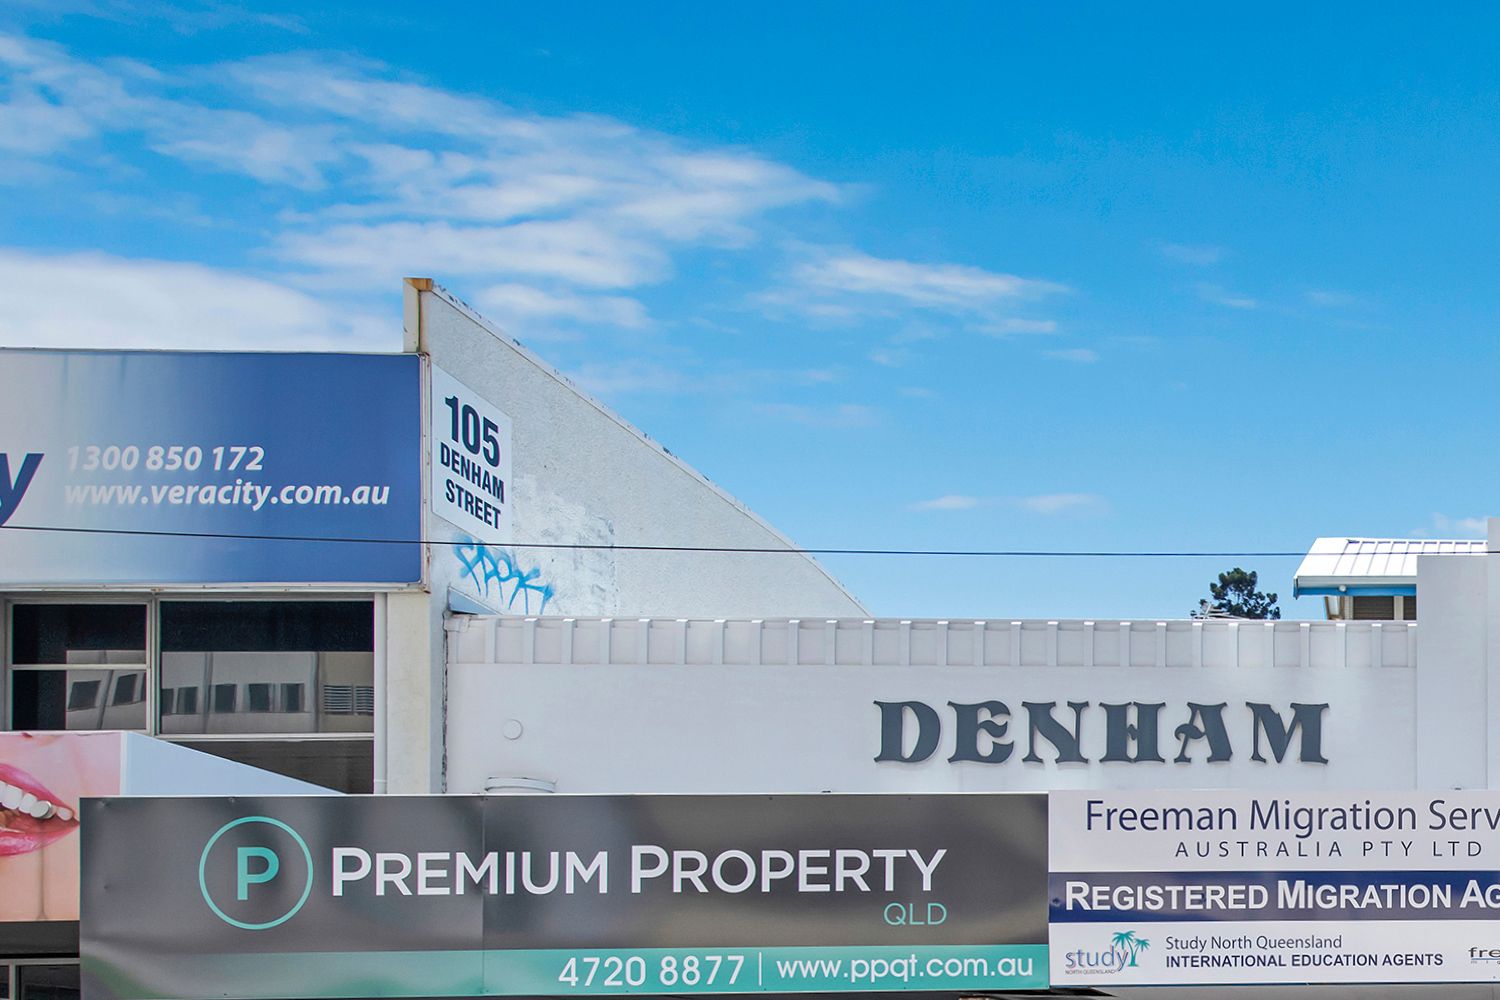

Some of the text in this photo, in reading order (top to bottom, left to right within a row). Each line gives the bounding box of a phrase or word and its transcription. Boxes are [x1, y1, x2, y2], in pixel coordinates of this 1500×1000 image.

[444, 395, 501, 468] 105
[67, 445, 264, 471] 1300 850 172
[440, 445, 504, 504] DENHAM
[64, 477, 389, 512] www.veracity.com.au
[444, 478, 501, 530] STREET
[873, 699, 1330, 764] DENHAM
[1086, 800, 1237, 831] Freeman
[1250, 799, 1417, 838] Migration
[1175, 840, 1483, 858] AUSTRALIA PTY LTD
[237, 846, 280, 901] P
[332, 845, 947, 897] PREMIUM PROPERTY
[1066, 881, 1268, 911] REGISTERED
[1278, 880, 1451, 910] MIGRATION
[884, 903, 947, 928] QLD
[1065, 945, 1128, 972] study
[1166, 935, 1342, 953] Study North Queensland
[1166, 953, 1443, 969] INTERNATIONAL EDUCATION AGENTS
[558, 952, 1033, 987] 4720 8877 www.ppqt.com.au
